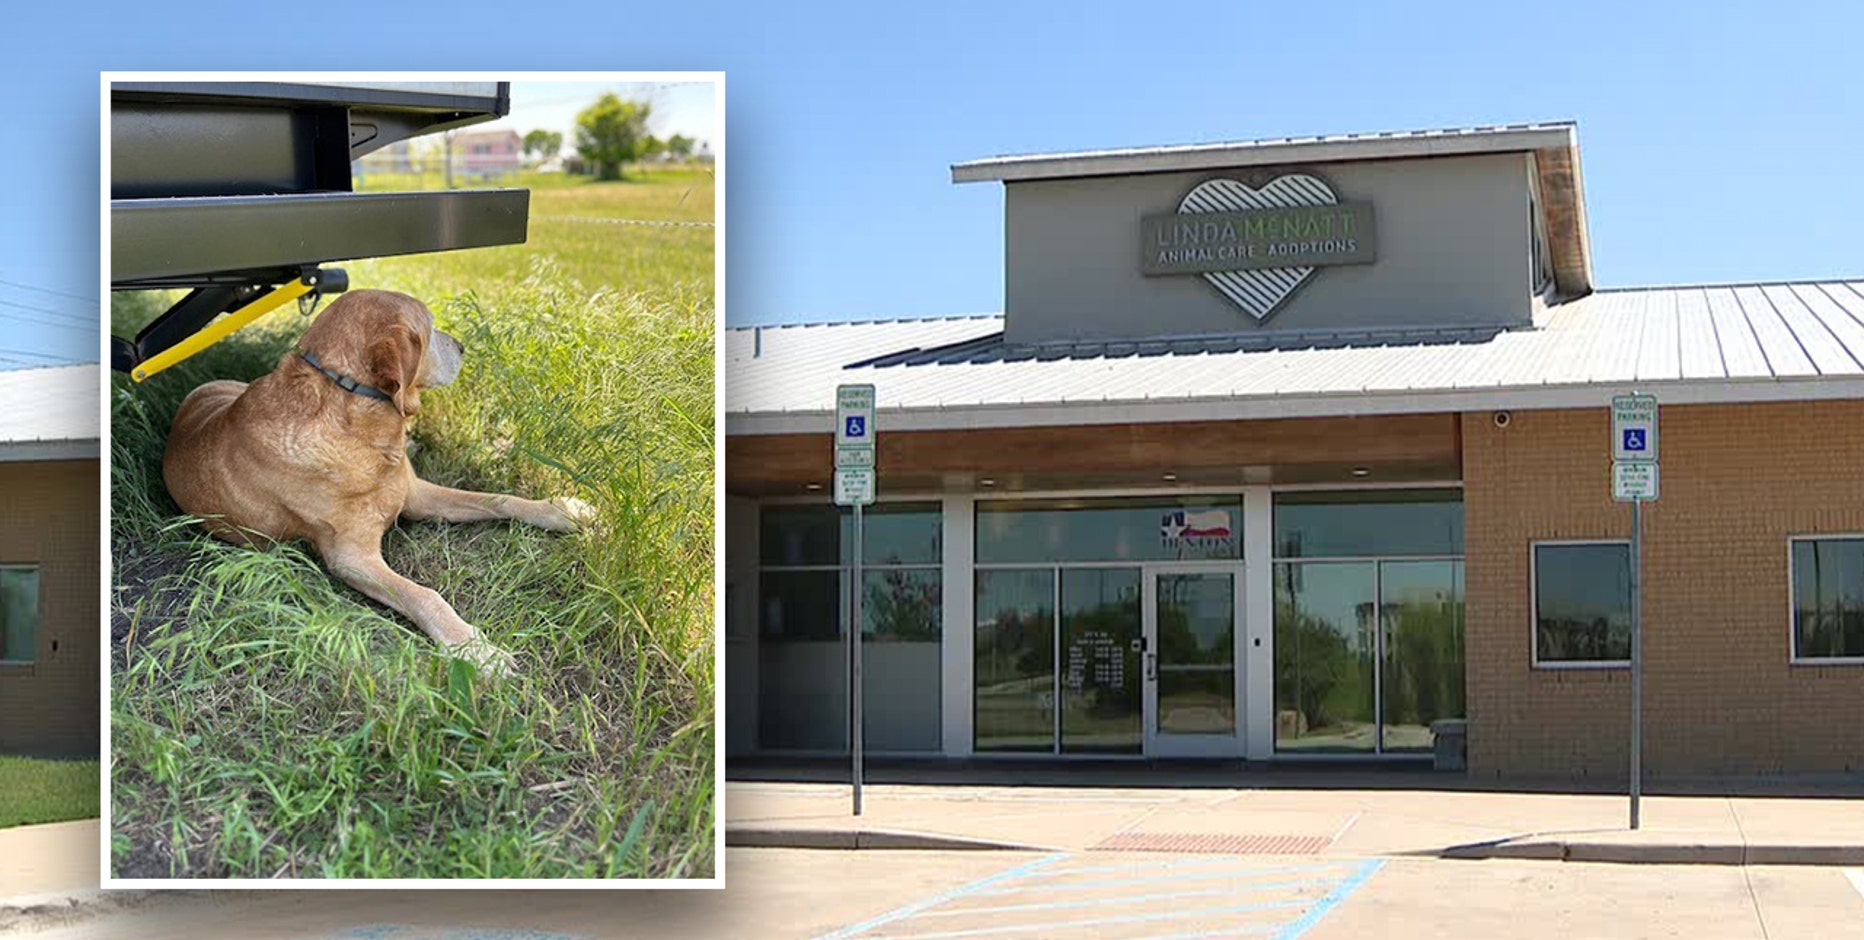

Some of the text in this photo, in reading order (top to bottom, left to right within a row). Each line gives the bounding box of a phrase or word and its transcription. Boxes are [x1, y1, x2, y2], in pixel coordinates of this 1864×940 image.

[1158, 220, 1237, 246] LINDA
[1159, 239, 1357, 263] ANIMAL CARE ADOPTIONS
[1617, 412, 1651, 421] PARKING
